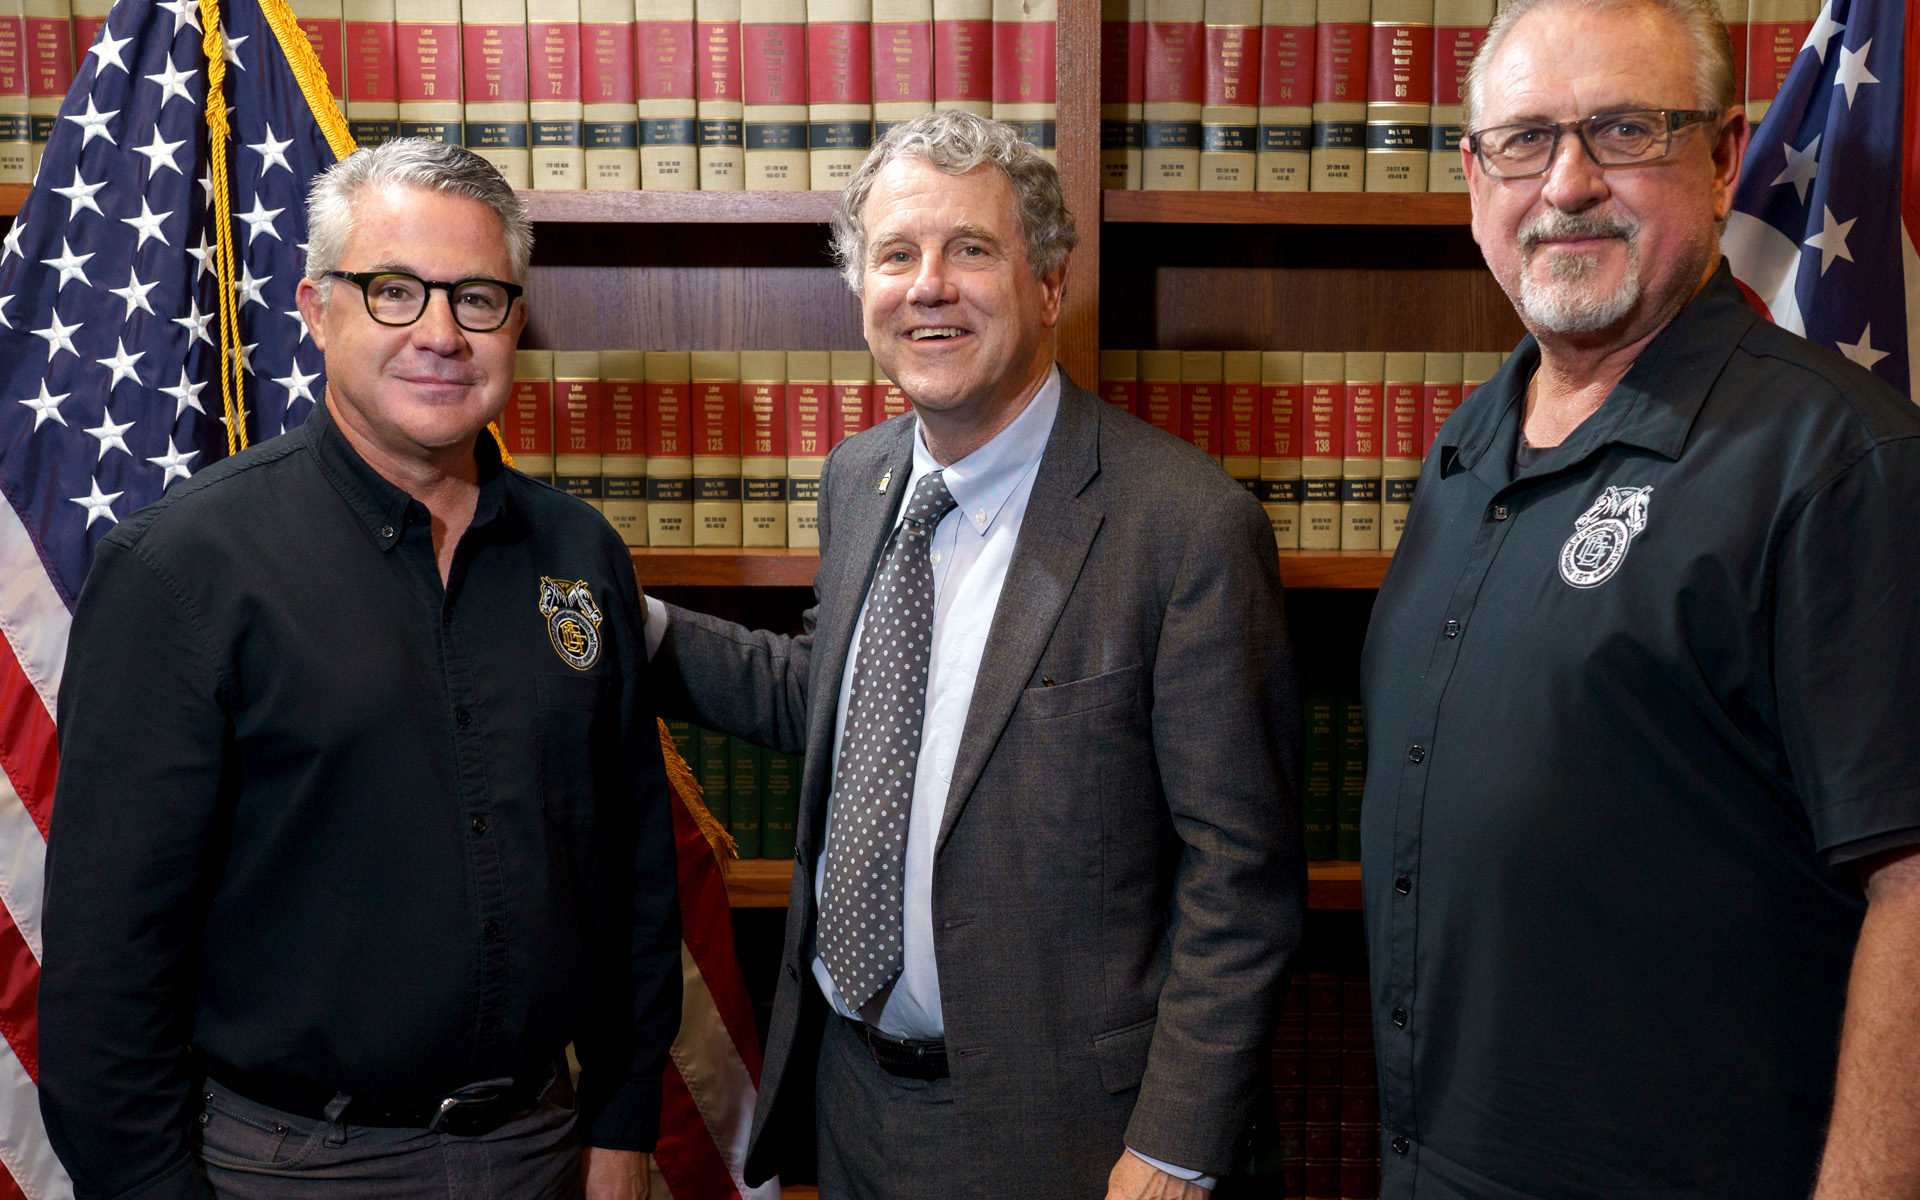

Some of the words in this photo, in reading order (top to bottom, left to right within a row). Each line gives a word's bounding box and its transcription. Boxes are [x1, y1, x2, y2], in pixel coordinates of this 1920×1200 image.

[3, 77, 13, 88] 63
[44, 78, 54, 89] 64
[550, 82, 562, 94] 72
[662, 82, 672, 93] 74
[715, 81, 726, 94] 75
[899, 82, 909, 94] 78
[958, 81, 968, 93] 79
[424, 83, 434, 95] 70
[489, 83, 499, 96] 71
[602, 84, 612, 96] 73
[1169, 85, 1179, 95] 82
[1225, 87, 1236, 99] 83
[1281, 87, 1292, 99] 84
[1335, 84, 1346, 95] 85
[1395, 85, 1407, 97] 86
[520, 438, 535, 450] 121
[570, 437, 586, 449] 122
[616, 438, 632, 450] 123
[662, 440, 677, 452] 124
[707, 439, 723, 451] 125
[756, 440, 771, 452] 126
[801, 440, 816, 452] 127
[1236, 440, 1250, 452] 136
[1274, 441, 1290, 454] 137
[1315, 440, 1330, 452] 138
[1357, 440, 1371, 452] 139
[1398, 441, 1412, 453] 140
